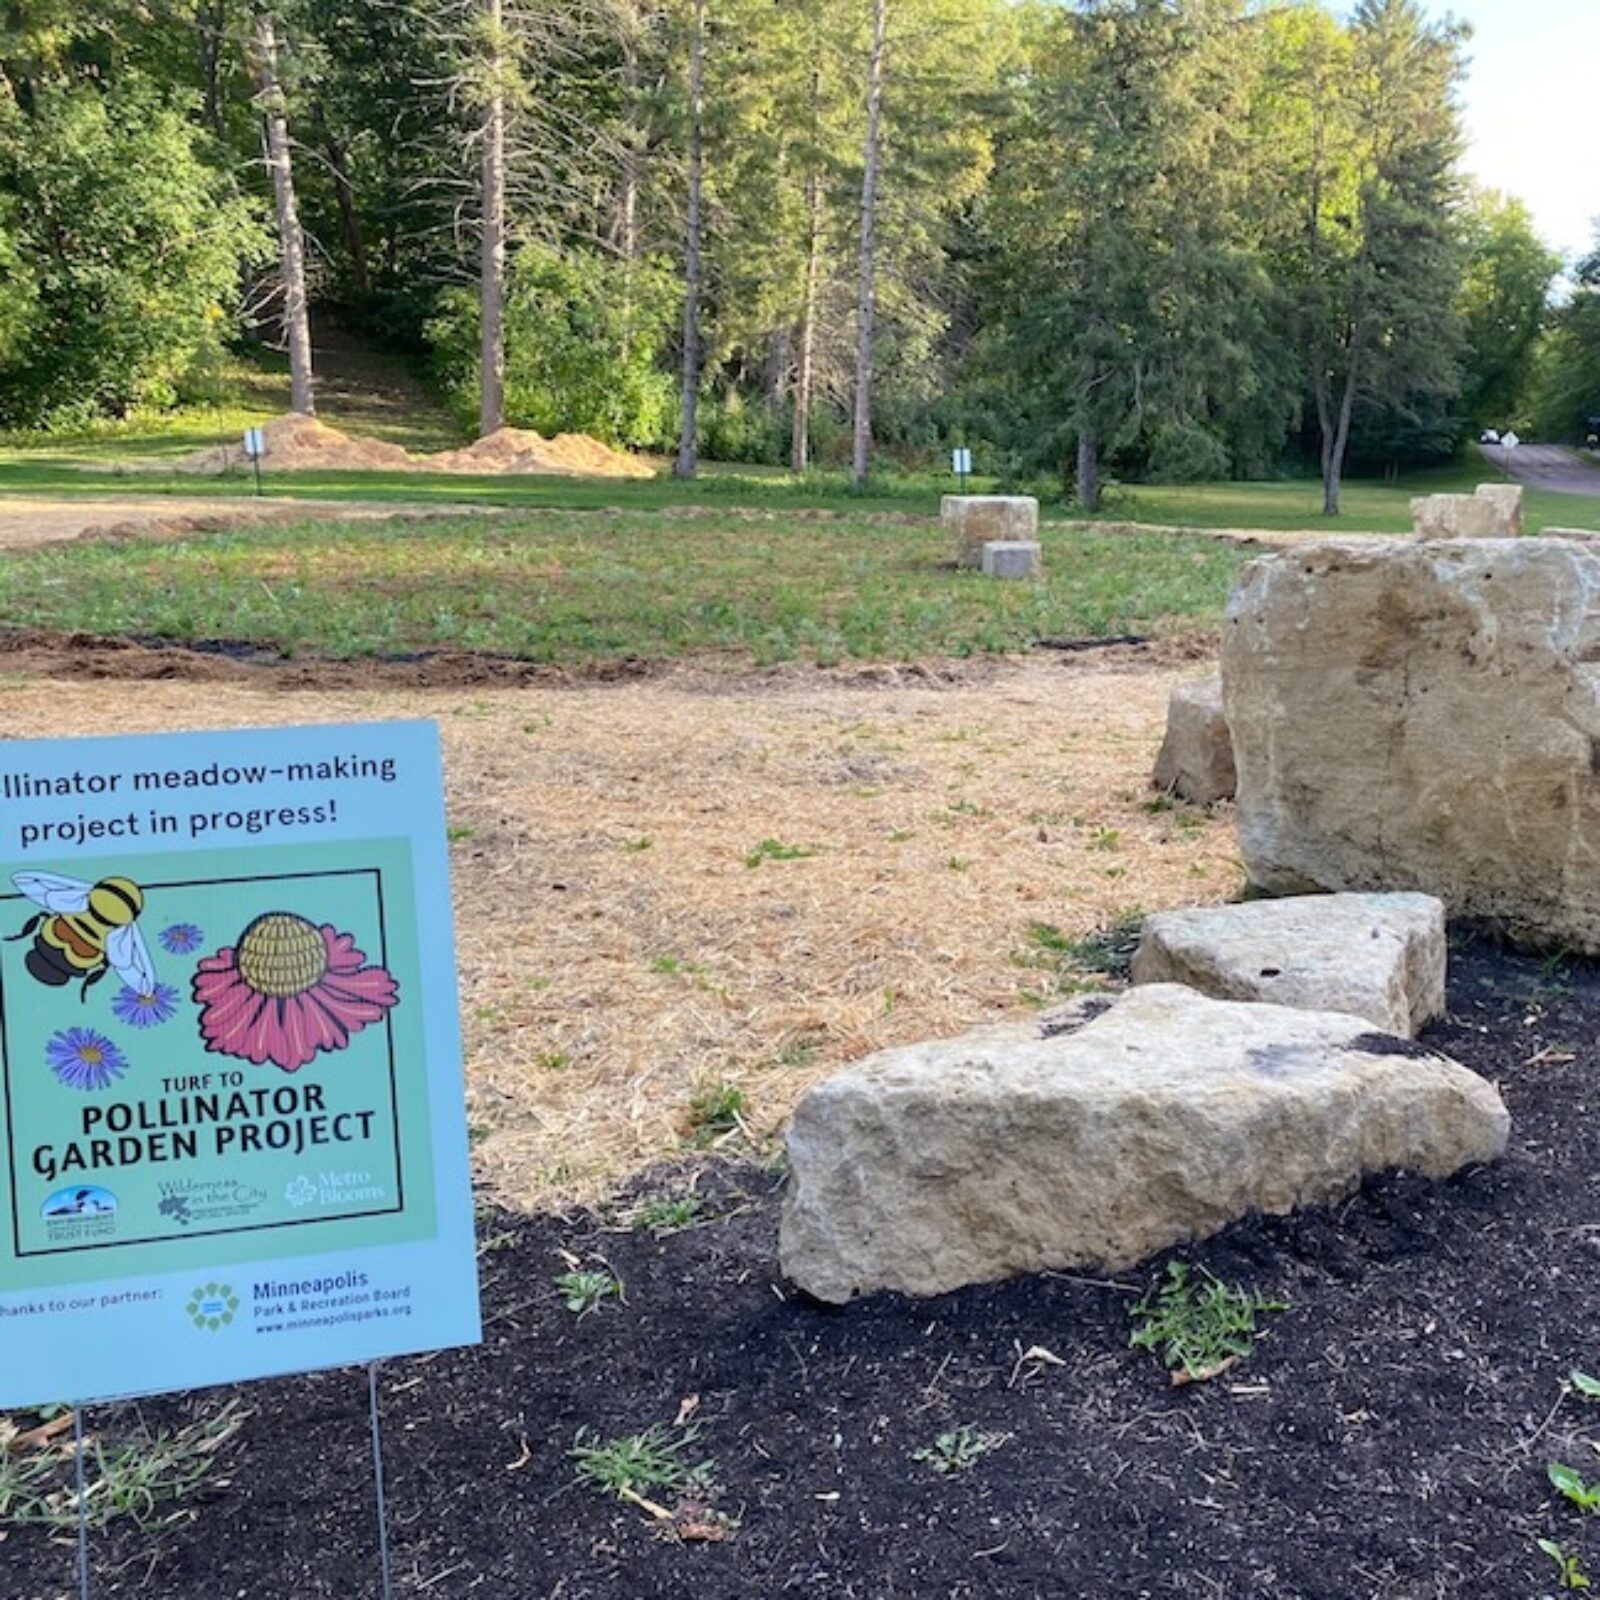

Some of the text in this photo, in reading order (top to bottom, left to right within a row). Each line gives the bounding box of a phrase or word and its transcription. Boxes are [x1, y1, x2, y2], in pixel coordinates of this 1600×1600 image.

[0, 755, 397, 799] llinator meadow-making
[21, 800, 337, 848] project in progress!
[162, 1071, 244, 1093] TURF TO
[82, 1084, 327, 1135] POLLINATOR
[33, 1111, 376, 1181] GARDEN PROJECT
[49, 1301, 66, 1312] to
[69, 1297, 95, 1309] our
[100, 1289, 163, 1308] partner:
[253, 1270, 369, 1300] Minneapolis
[254, 1285, 411, 1318] Park & Recreation Board
[256, 1304, 412, 1334] www.minneapolisparks.org
